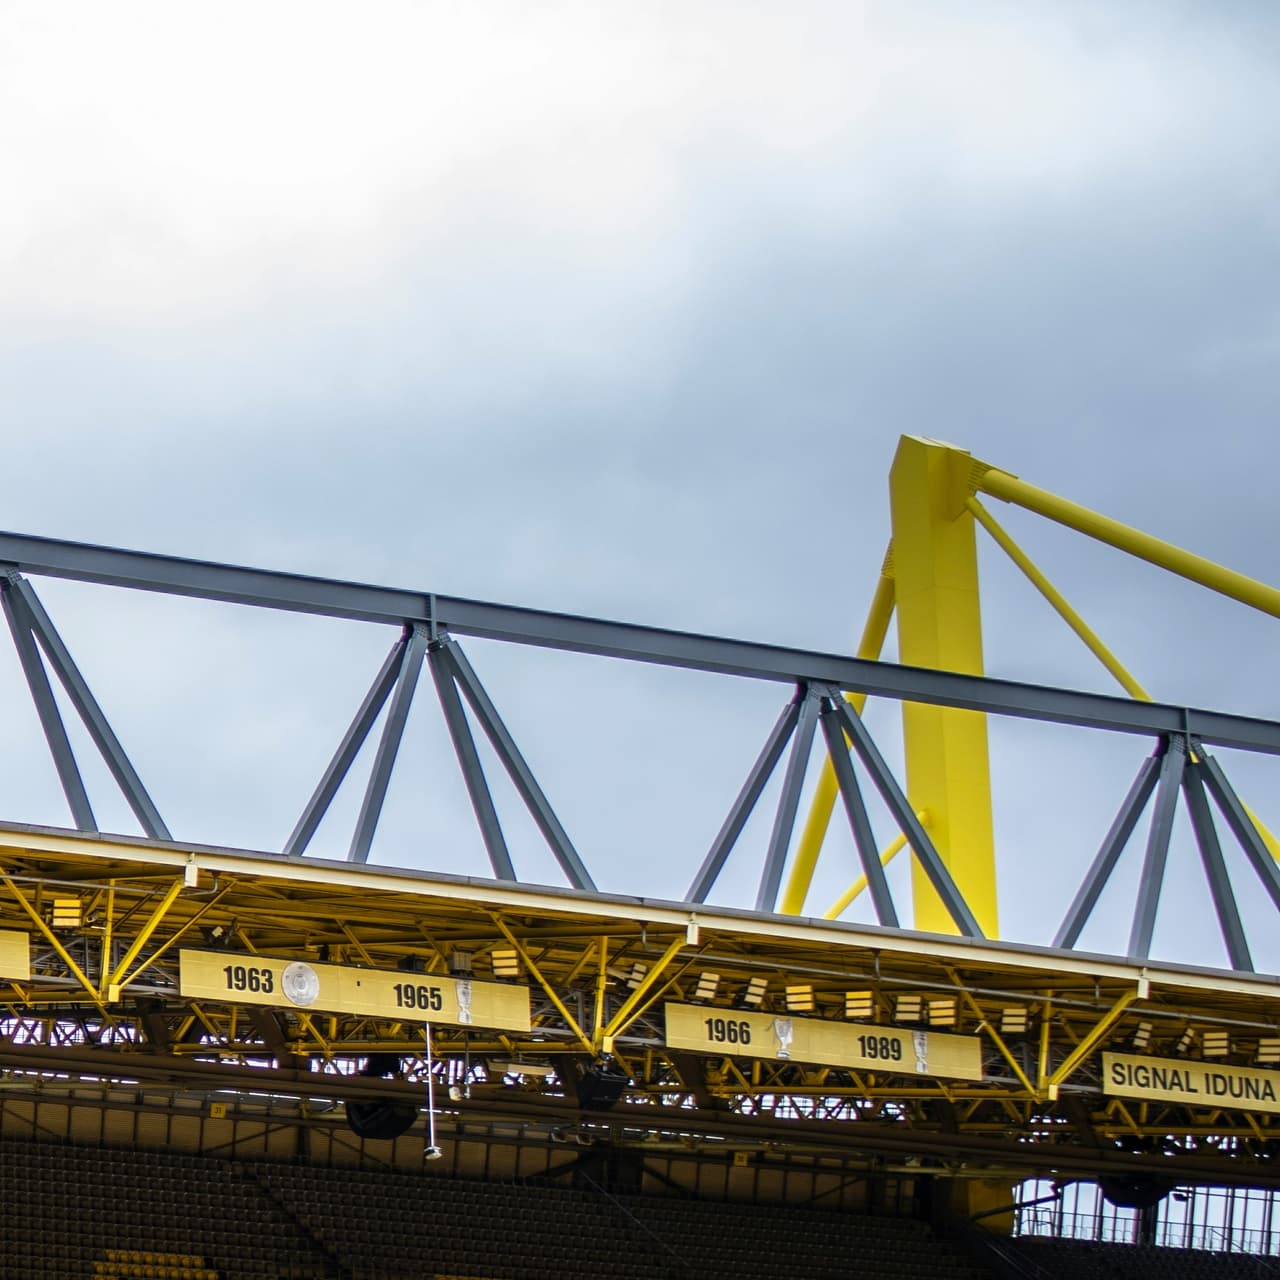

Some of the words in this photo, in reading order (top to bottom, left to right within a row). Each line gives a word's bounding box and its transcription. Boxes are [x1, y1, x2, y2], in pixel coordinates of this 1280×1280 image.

[223, 965, 274, 994] 1963
[393, 983, 443, 1011] 1965
[704, 1017, 751, 1045] 1966
[857, 1035, 902, 1061] 1989
[1111, 1062, 1198, 1095] SIGNAL
[1204, 1072, 1277, 1102] IDUNA
